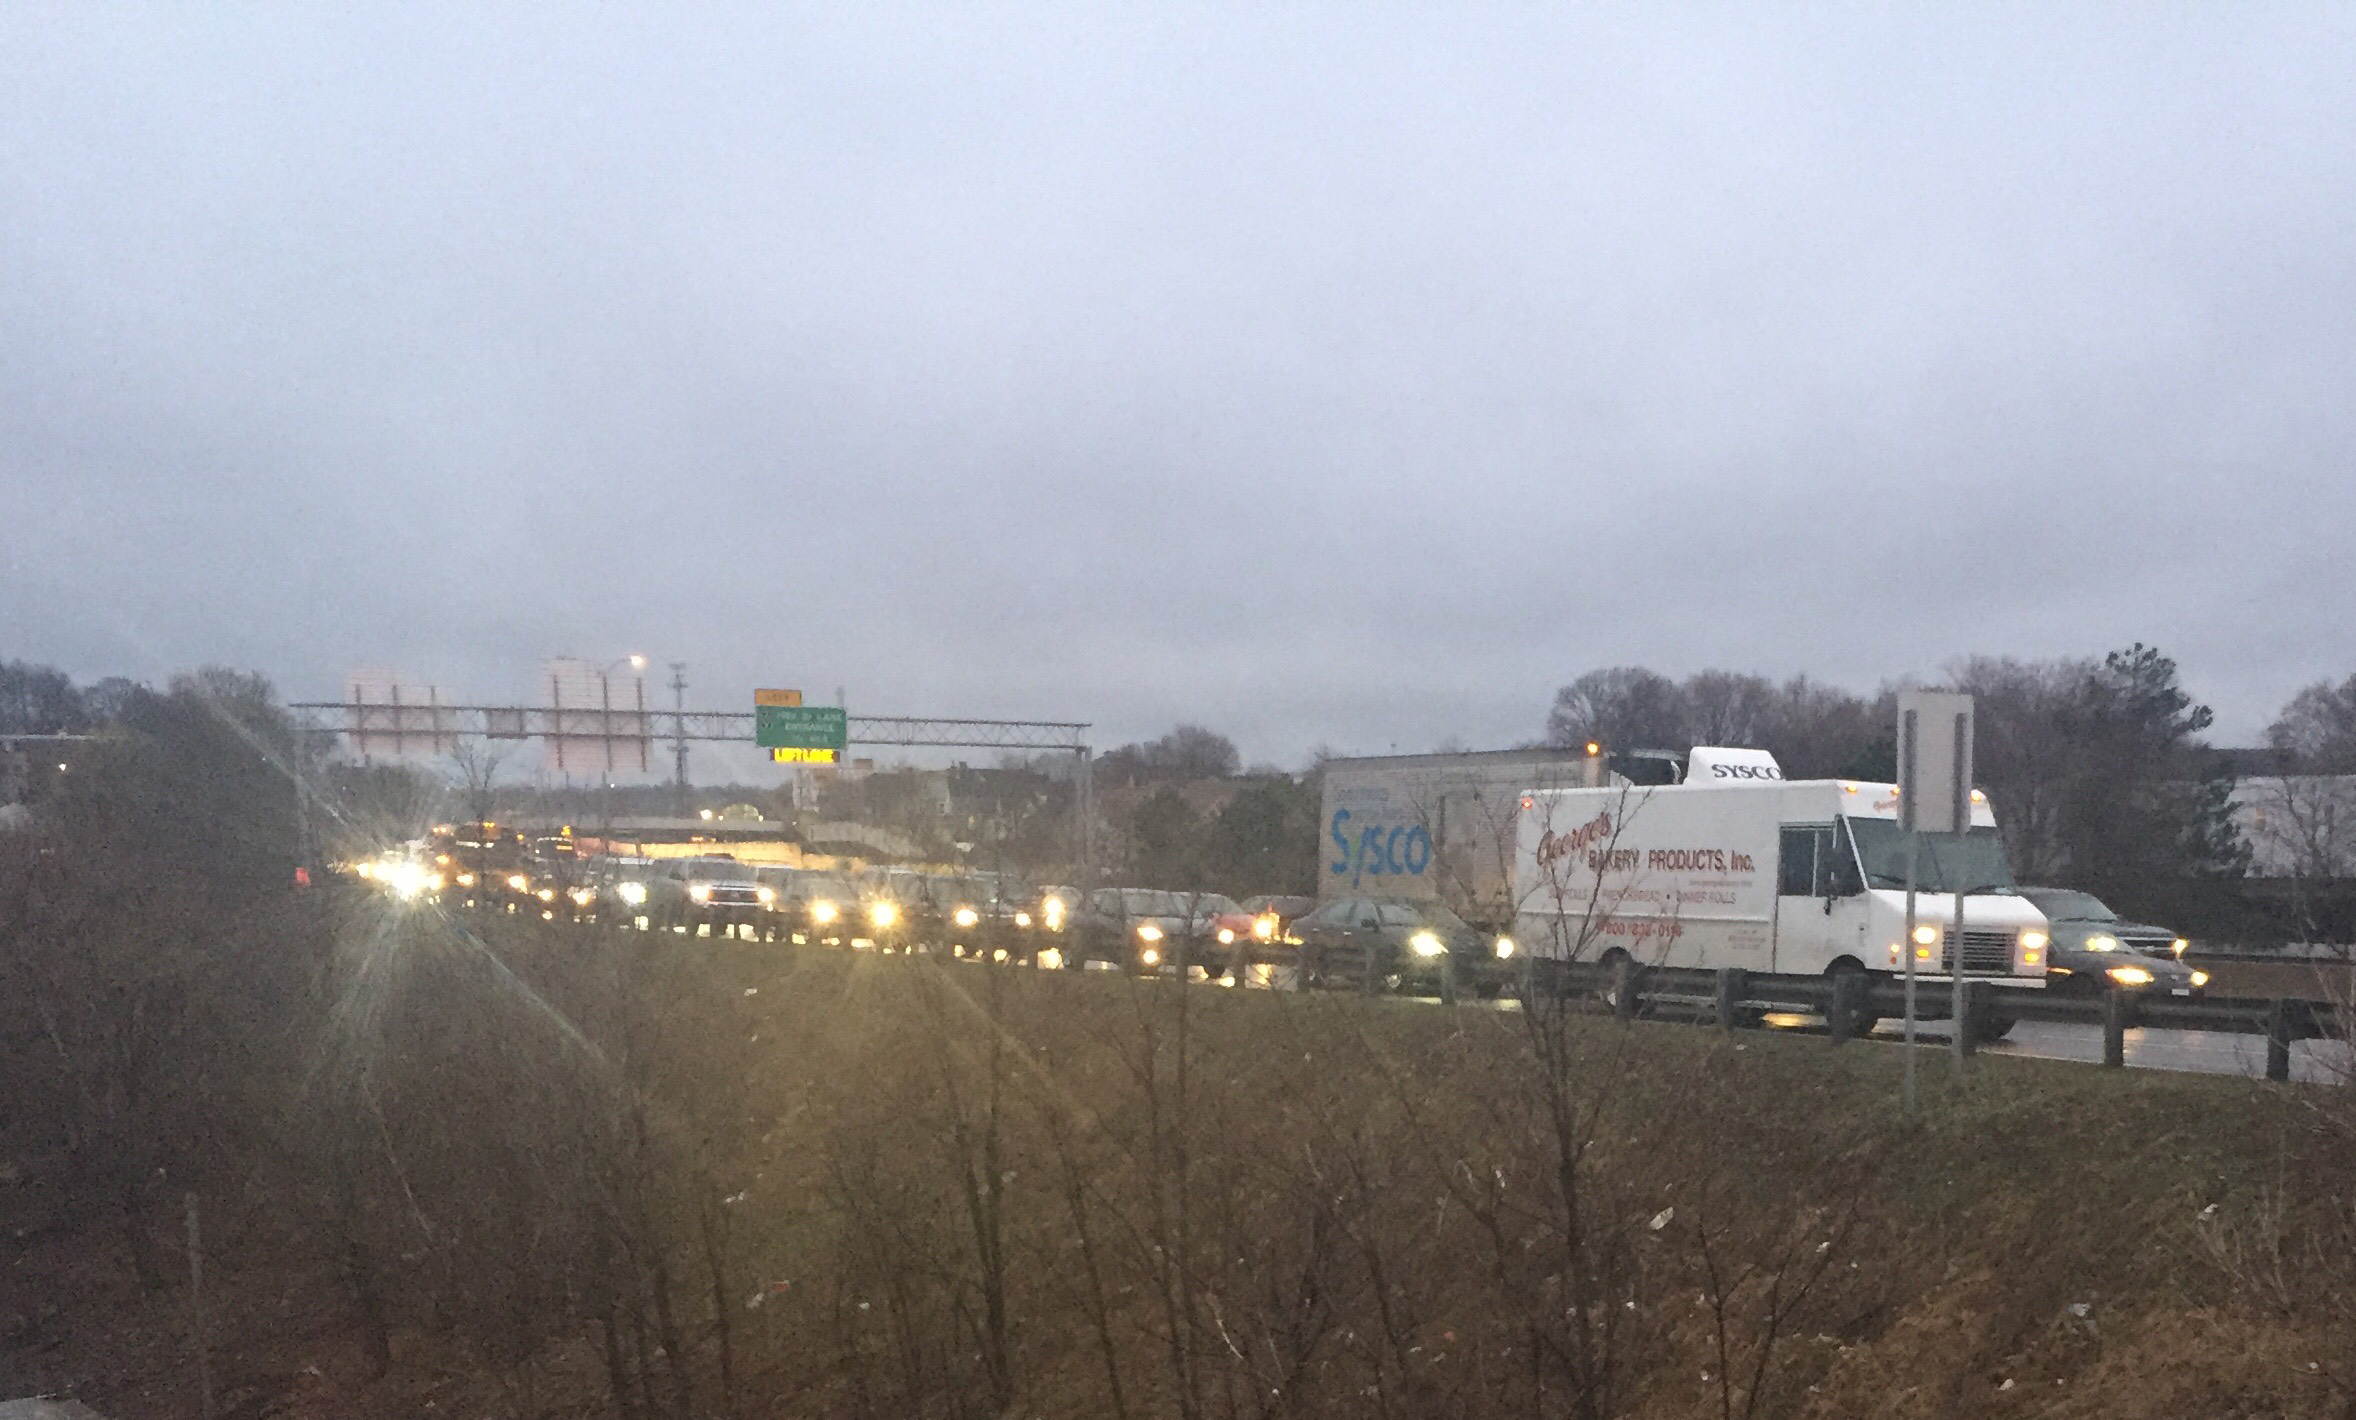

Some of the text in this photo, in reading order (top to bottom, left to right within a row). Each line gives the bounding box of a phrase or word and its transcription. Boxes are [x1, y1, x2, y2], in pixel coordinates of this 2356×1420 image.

[1711, 763, 1782, 781] SYSCO
[1588, 849, 1640, 872] BAKERY
[1730, 850, 1755, 872] Inc.
